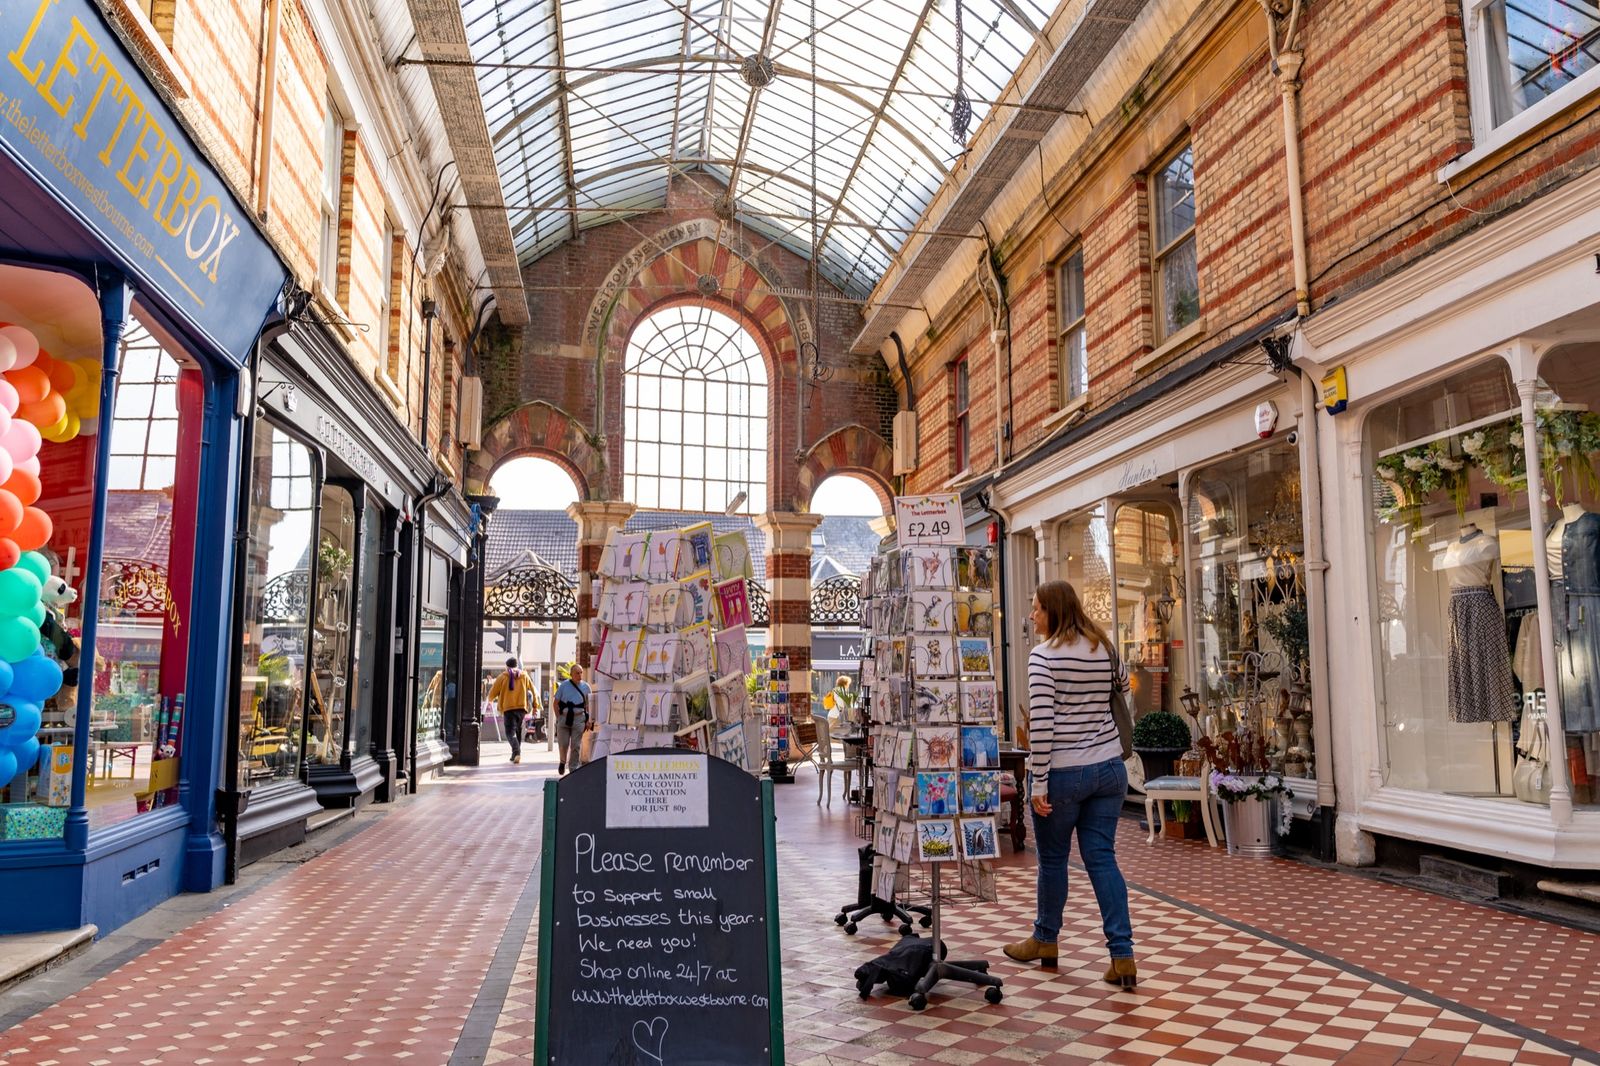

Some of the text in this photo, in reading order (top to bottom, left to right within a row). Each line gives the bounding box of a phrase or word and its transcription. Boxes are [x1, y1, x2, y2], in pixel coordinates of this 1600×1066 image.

[8, 0, 240, 284] LETTERBOX
[1118, 460, 1159, 488] Hunter's
[908, 520, 950, 537] £2.49
[652, 772, 698, 780] LAMINATE
[624, 788, 687, 796] VACCINATION
[649, 805, 669, 813] JUST
[673, 804, 687, 813] 80p
[575, 833, 754, 874] Please remember
[572, 883, 595, 904] to
[674, 886, 717, 901] small
[577, 908, 671, 928] businesses
[678, 908, 713, 925] this
[579, 933, 698, 953] We need you!
[580, 958, 738, 986] Shop online 24/7 at
